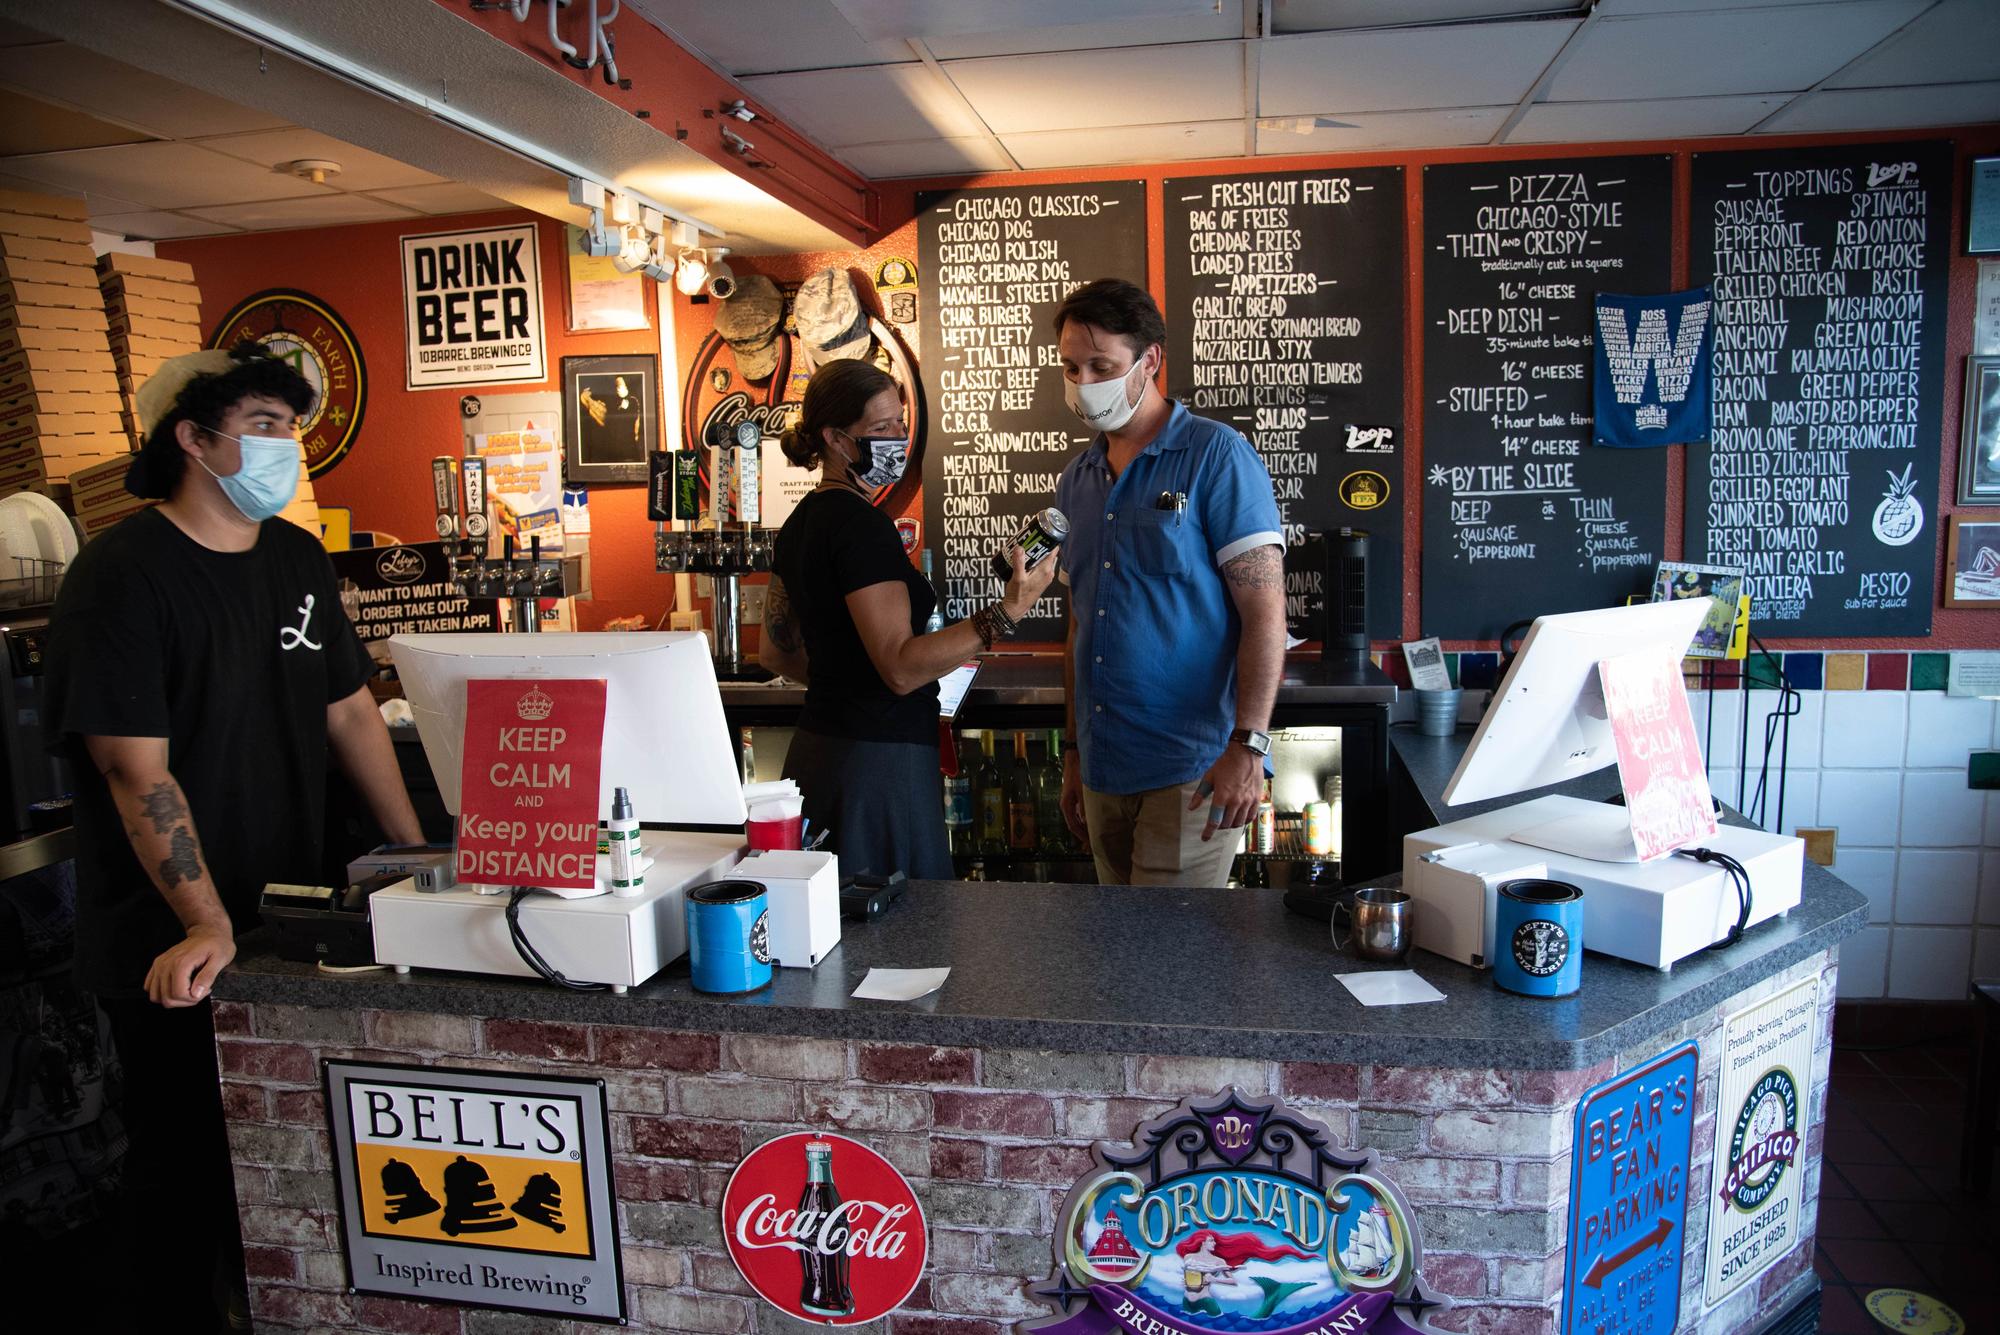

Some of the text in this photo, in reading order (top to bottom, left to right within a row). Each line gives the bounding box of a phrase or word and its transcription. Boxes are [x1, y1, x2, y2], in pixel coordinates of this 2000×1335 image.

[1212, 179, 1349, 207] FRESH CUT FRIES
[1510, 173, 1589, 202] PIZZA
[1754, 168, 1853, 197] TOPPINGS
[955, 196, 1099, 221] CHICAGO CLASSICS
[1190, 208, 1288, 230] BAG OF FRIES
[1477, 202, 1622, 230] CHICAGO-STYLE
[1447, 230, 1588, 257] THIN AND CRISPY
[1837, 219, 1926, 245] RED ONION
[414, 238, 526, 292] DRINK
[939, 262, 1039, 284] CHAR-CHEDDAR
[1042, 261, 1069, 280] DOG
[1481, 258, 1623, 275] traditionally cut in squares
[940, 286, 1002, 306] MAXWELL
[1006, 282, 1058, 303] STREET
[1231, 274, 1317, 295] APPETIZERS
[1528, 285, 1576, 299] CHEESE
[416, 287, 530, 346] BEER
[1597, 307, 1624, 316] LESTER
[1641, 309, 1665, 320] ROSS
[1683, 301, 1711, 314] ZOBRIST
[1826, 295, 1922, 321] MUSHROOM
[1193, 317, 1361, 340] ARTICHOKE SPINACH BREAD
[1448, 307, 1542, 334] DEEP DISH
[1678, 326, 1704, 335] ALMORA
[942, 326, 1032, 347] HEFTY LEFTY
[1486, 337, 1580, 353] 35-minute bake
[1633, 343, 1671, 352] ARRIETA
[1636, 333, 1670, 342] RUSSELL
[1713, 325, 1788, 351] ANCHOVY
[311, 327, 346, 389] EARTH
[420, 345, 517, 363] 10 BARREL BREWING
[1193, 340, 1312, 361] MOZZARELLA STYX
[1654, 356, 1696, 368] BRYANT
[1673, 348, 1698, 357] SMITH
[1194, 363, 1362, 386] BUFFALO CHICKEN TENDERS
[1610, 359, 1648, 369] FOWLER
[1656, 366, 1692, 376] HENDRICKS
[941, 368, 1039, 390] CLASSIC BEEF
[1612, 376, 1646, 384] LACKEY
[1658, 375, 1690, 387] RIZZO
[1659, 386, 1688, 395] STROP
[1195, 386, 1305, 409] ONION RINGS
[1617, 393, 1641, 403] BAEZ
[1660, 394, 1685, 402] WOOD
[942, 413, 992, 432] C.B.G.B.
[1256, 408, 1306, 430] SALADS
[1636, 409, 1666, 417] WORLD
[1636, 418, 1666, 426] SERIES
[974, 432, 1067, 453] SANDWICHES
[1252, 431, 1300, 450] VEGGIE
[1532, 440, 1580, 455] CHEESE
[1809, 424, 1917, 449] PEPPERONCINI
[944, 455, 1011, 475] MEATBALL
[1710, 451, 1849, 477] GRILLED ZUCCHINI
[1451, 463, 1574, 490] BY THE SLICE
[944, 496, 989, 516] COMBO
[1707, 502, 1848, 527] SUNDRIED TOMATO
[944, 516, 1018, 536] KATARINA'S
[1460, 526, 1518, 549] SAUSAGE
[1585, 522, 1629, 538] CHEESE
[1469, 543, 1536, 564] PEPPERONI
[359, 583, 442, 603] WANT TO WAIT
[1859, 572, 1910, 597] PESTO
[363, 600, 468, 621] ORDER TAKE OUT?
[373, 614, 490, 637] ON THE TAKEIN APP!
[499, 728, 567, 752] KEEP
[1632, 726, 1683, 760] CALM
[489, 763, 570, 789] CALM
[515, 795, 543, 808] AND
[461, 814, 596, 848] Keep your
[459, 850, 595, 880] DISTANCE
[1518, 922, 1564, 938] LEFTY'S
[1516, 954, 1566, 974] PIZZERIA
[1728, 998, 1814, 1052] Proudly Serving Chicago's
[1733, 1023, 1807, 1070] Finest Pickle Products
[364, 1090, 566, 1154] BELL'S
[1588, 1075, 1687, 1165] BEAR'S
[1732, 1075, 1794, 1161] CHICAGO PICKLE
[1215, 1116, 1252, 1149] CBC
[1610, 1134, 1661, 1195] FAN
[1738, 1163, 1783, 1203] COMPANY
[1584, 1165, 1681, 1256] PARKING
[736, 1194, 913, 1259] Coca-Cola
[1722, 1198, 1788, 1257] RELISHED
[1721, 1239, 1760, 1282] SINCE
[1763, 1222, 1787, 1250] 1925
[373, 1253, 587, 1305] Inspired Brewing
[1579, 1249, 1673, 1328] ALL OTHERS
[1639, 1285, 1655, 1312] BE
